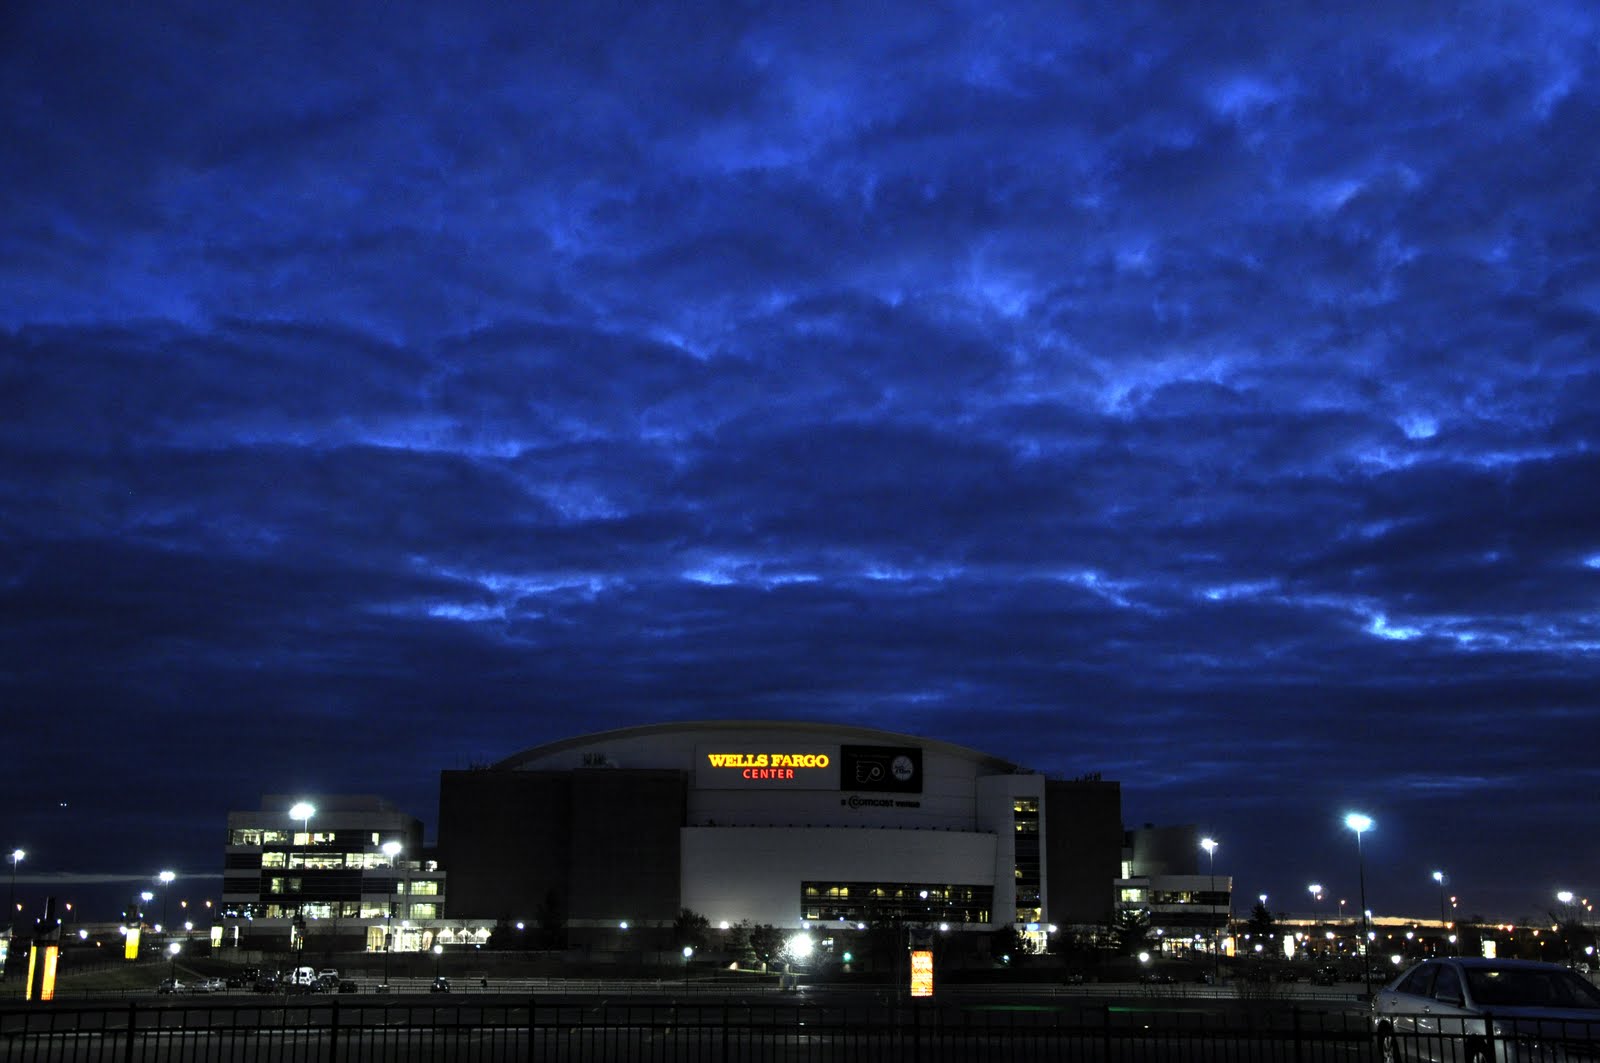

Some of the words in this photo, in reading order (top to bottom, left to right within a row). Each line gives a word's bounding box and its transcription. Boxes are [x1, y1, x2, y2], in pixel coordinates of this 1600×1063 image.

[708, 754, 768, 767] WELLS
[770, 754, 829, 768] FARGO
[742, 768, 794, 779] CENTER
